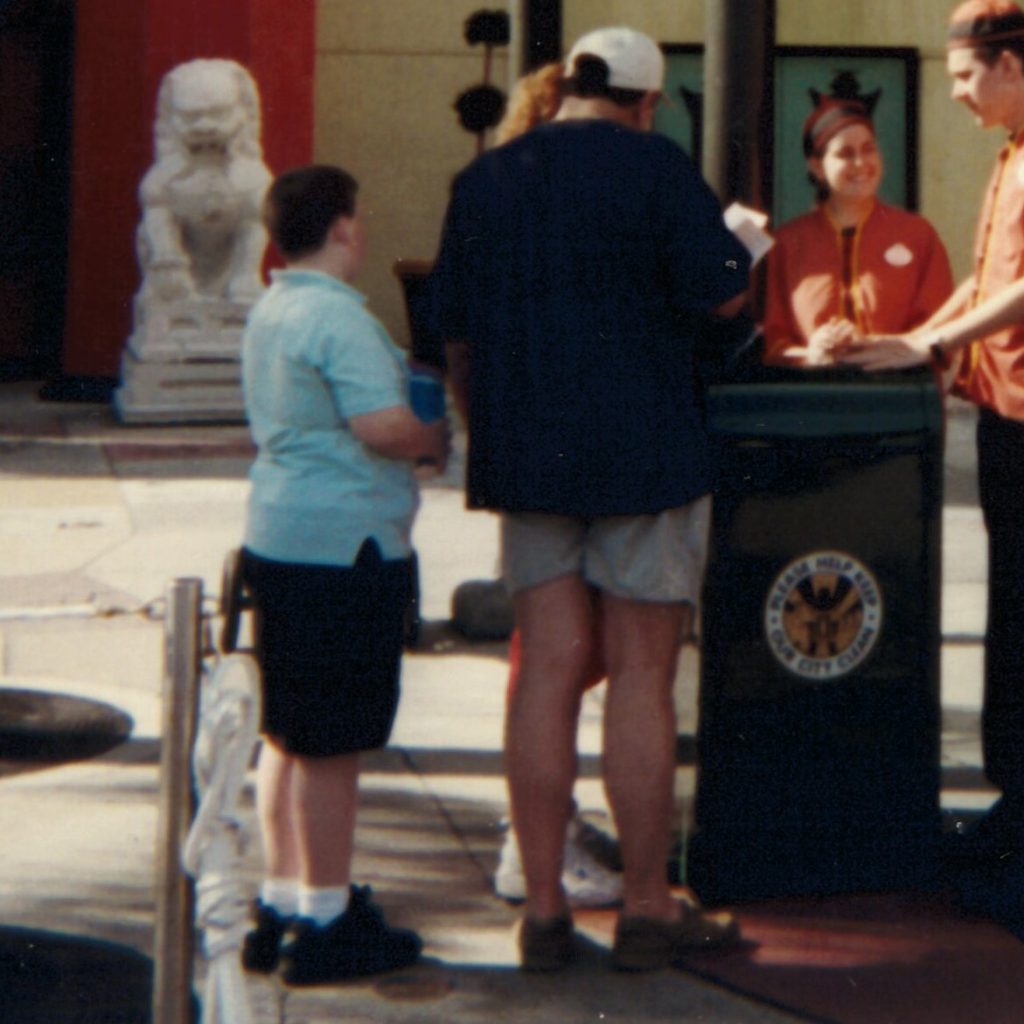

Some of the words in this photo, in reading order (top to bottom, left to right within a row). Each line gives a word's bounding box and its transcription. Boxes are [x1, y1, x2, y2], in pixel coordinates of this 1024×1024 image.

[771, 562, 810, 610] PLEASE
[816, 557, 853, 571] HELP
[854, 571, 877, 607] KEEP
[771, 629, 796, 661] OUR
[798, 660, 832, 673] CITY
[837, 627, 874, 669] CLEAN
